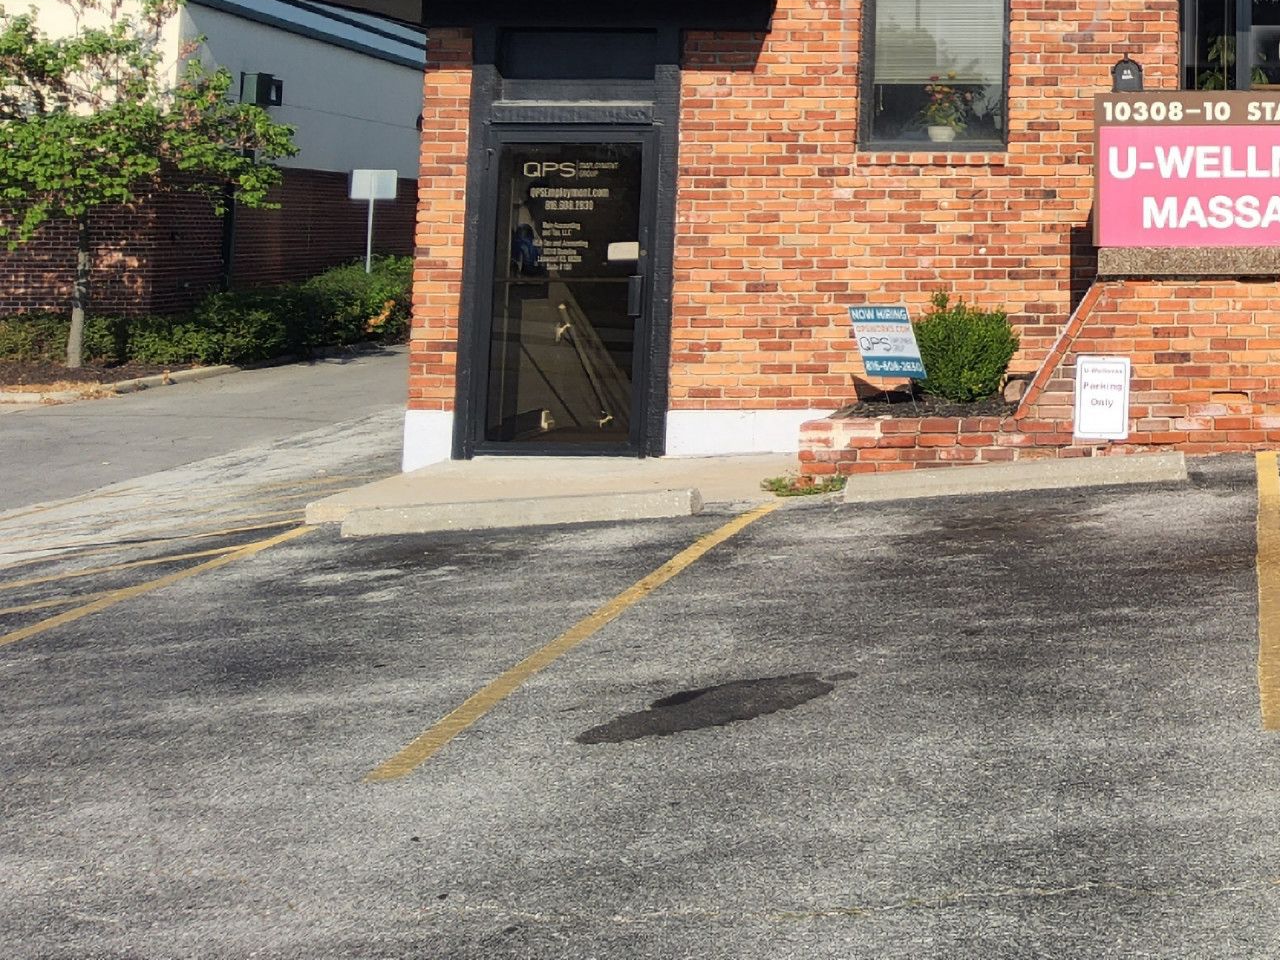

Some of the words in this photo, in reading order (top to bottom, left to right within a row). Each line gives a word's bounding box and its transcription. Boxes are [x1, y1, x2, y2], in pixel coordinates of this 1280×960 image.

[1102, 101, 1232, 122] 10308-10
[523, 161, 576, 178] QPS
[851, 308, 875, 320] NOW
[876, 307, 908, 321] HIRING
[859, 336, 892, 353] QPS
[1083, 381, 1123, 393] Parking
[1090, 397, 1114, 409] Only
